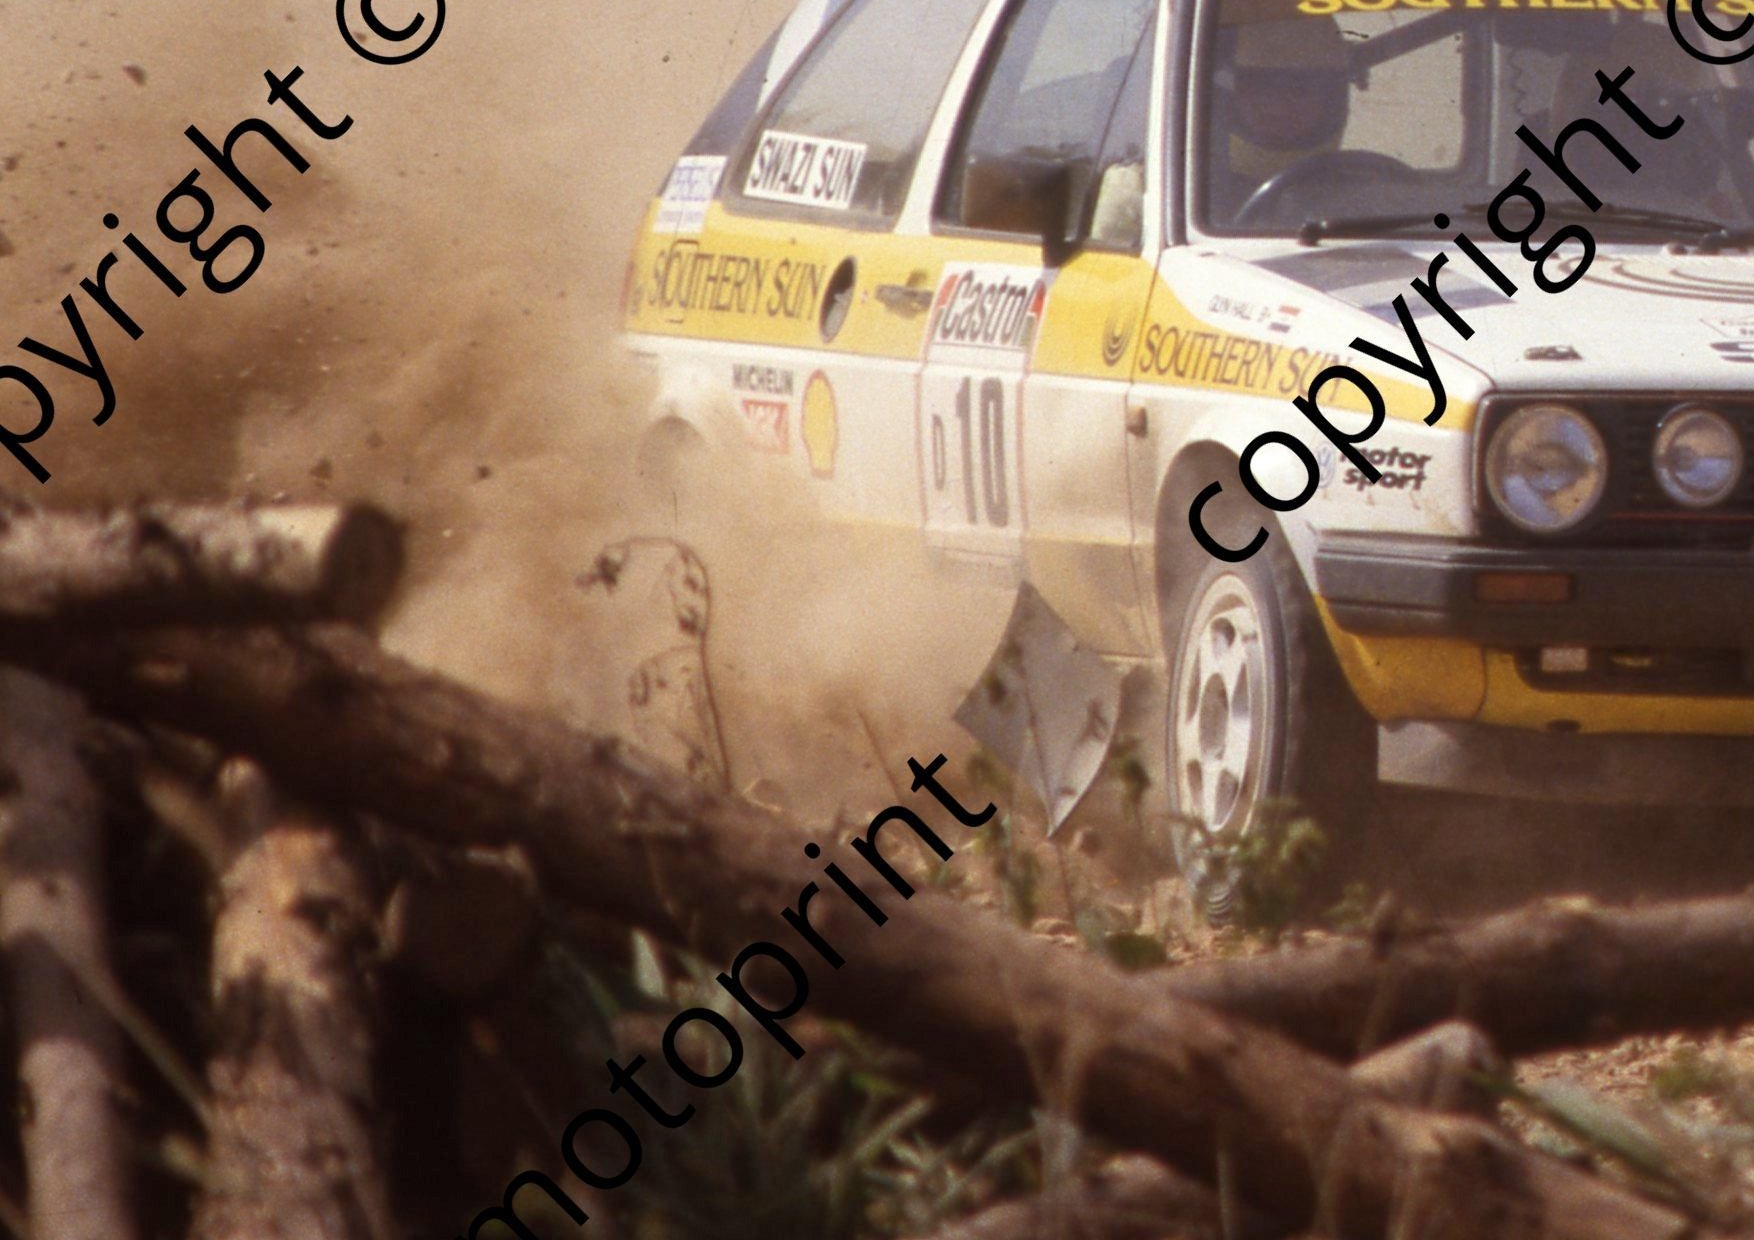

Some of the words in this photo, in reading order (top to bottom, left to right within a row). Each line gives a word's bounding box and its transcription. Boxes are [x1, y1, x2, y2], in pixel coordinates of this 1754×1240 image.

[750, 138, 818, 194] SWAZI
[813, 146, 862, 203] SUN
[648, 249, 769, 314] SOUTHERN
[766, 257, 827, 321] SUN
[940, 269, 1043, 346] Castrol
[732, 363, 794, 397] MICHELIN
[1140, 323, 1282, 389] SOUTHERN
[955, 376, 1010, 528] 10
